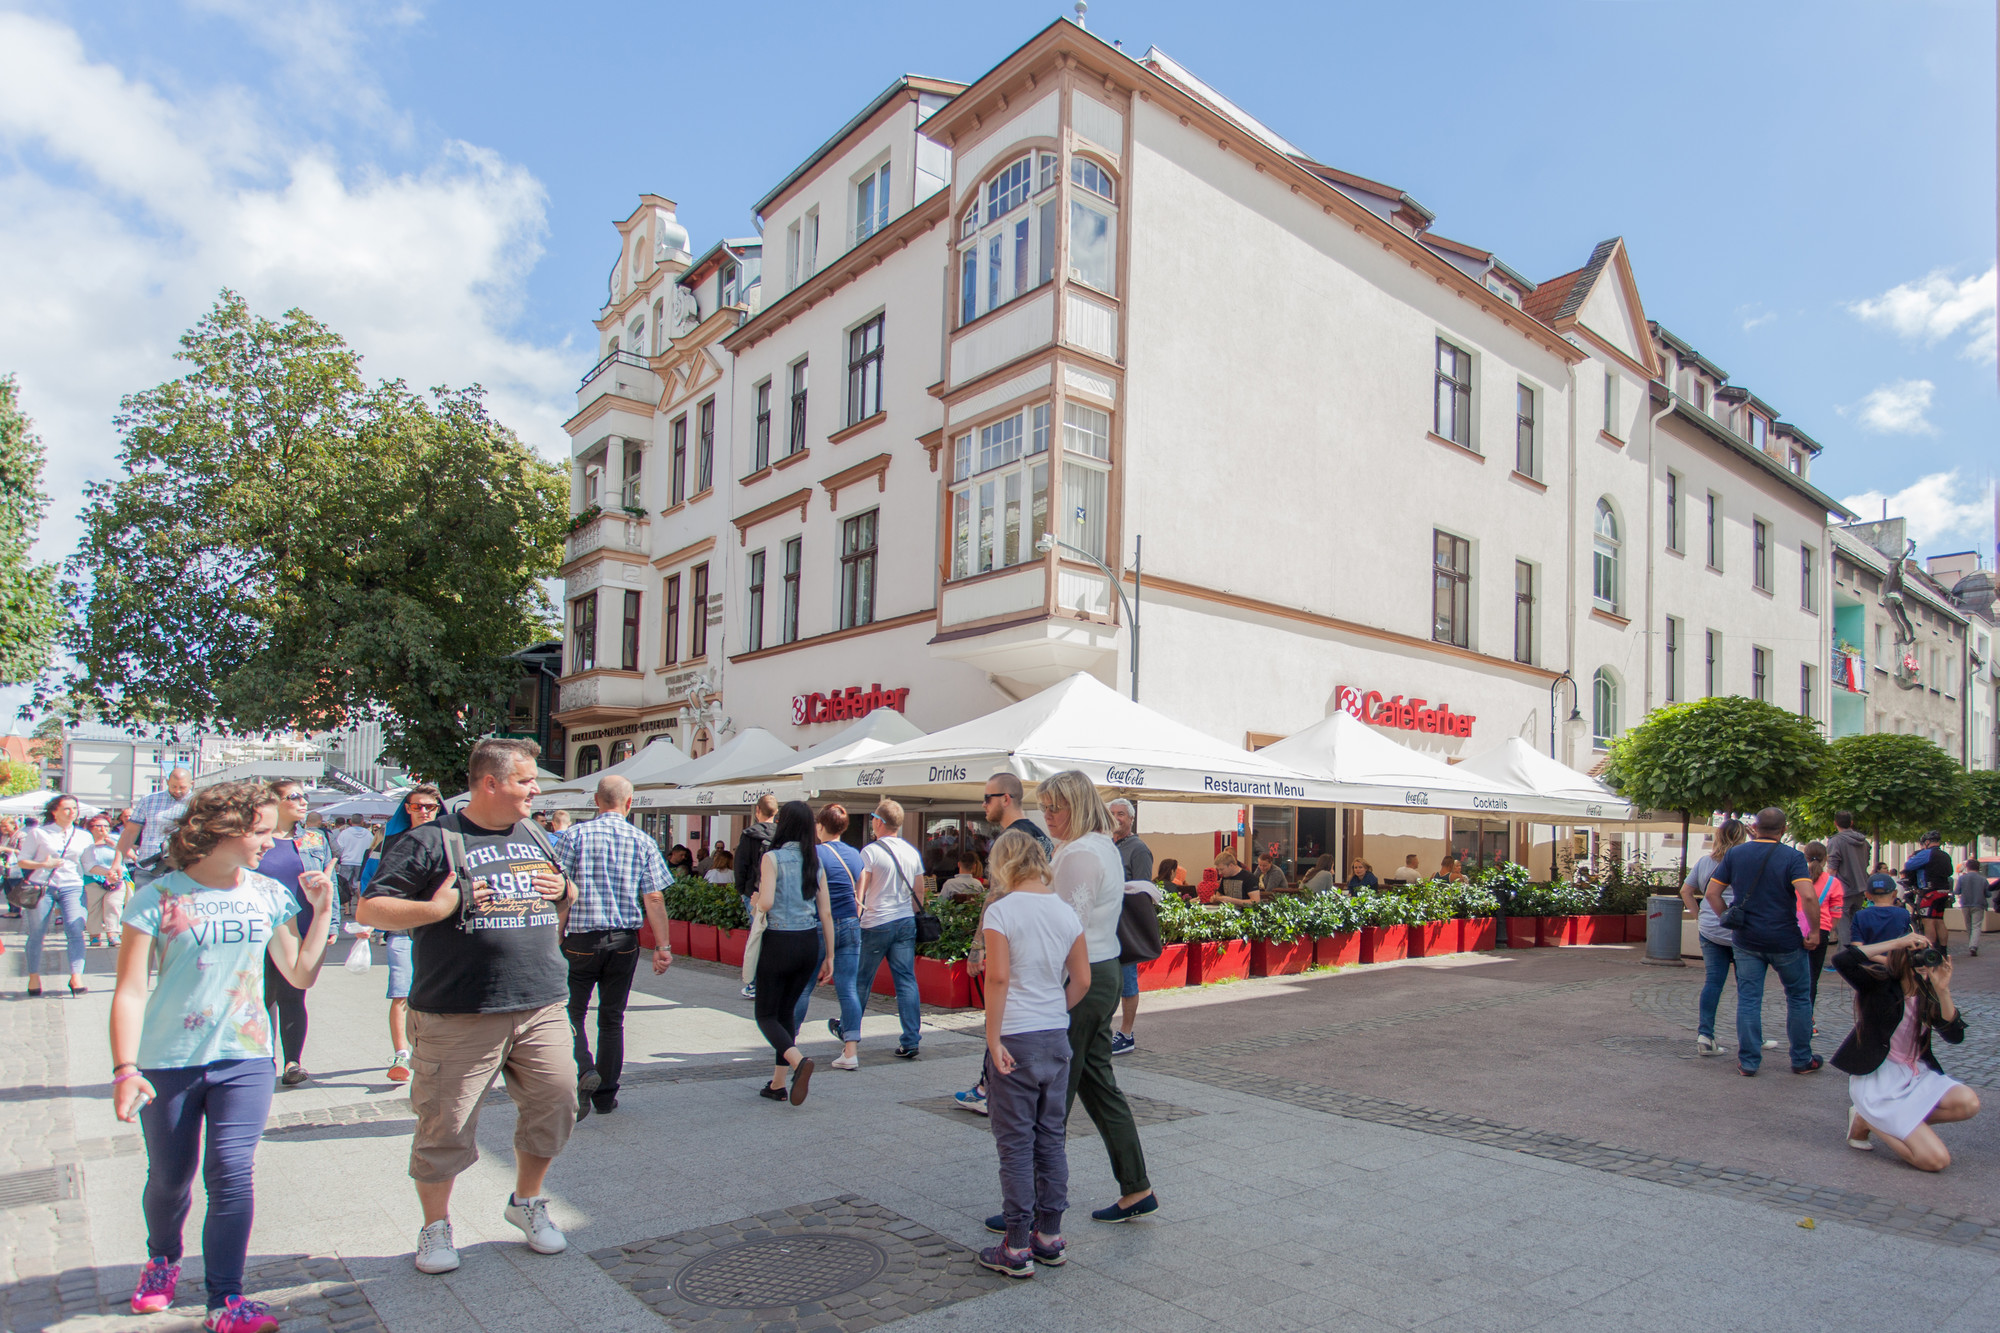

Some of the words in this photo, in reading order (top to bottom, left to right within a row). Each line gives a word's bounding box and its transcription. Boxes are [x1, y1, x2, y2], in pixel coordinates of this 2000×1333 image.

[1362, 690, 1476, 738] CafeFerber
[928, 764, 967, 782] Drinks
[1106, 765, 1145, 786] Coca-Cola
[1204, 775, 1271, 795] Restaurant
[1274, 781, 1305, 797] Menu
[1473, 796, 1508, 810] Cocktails
[184, 901, 265, 916] TROPICAL
[187, 918, 264, 947] VIBE
